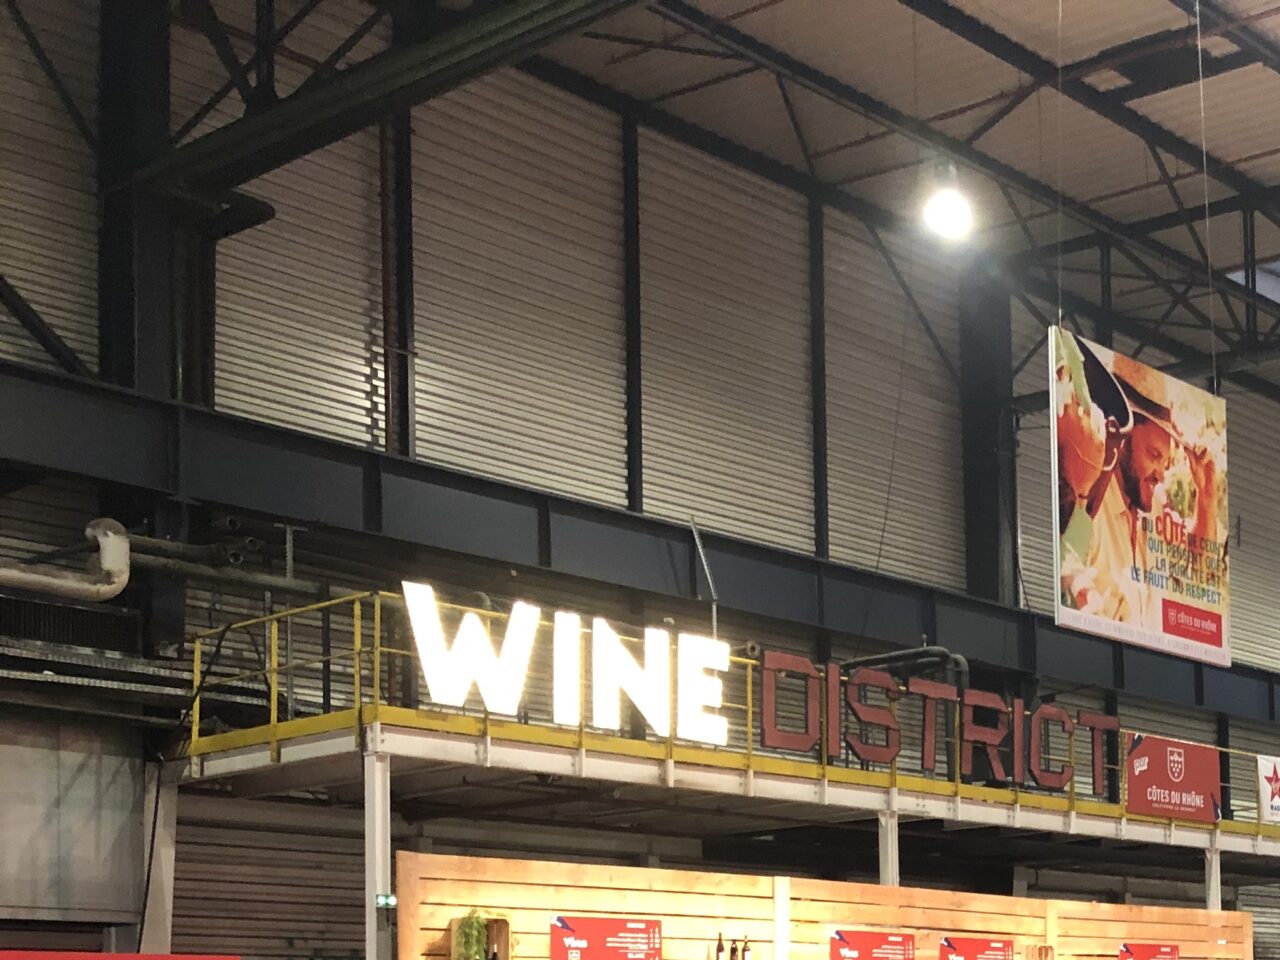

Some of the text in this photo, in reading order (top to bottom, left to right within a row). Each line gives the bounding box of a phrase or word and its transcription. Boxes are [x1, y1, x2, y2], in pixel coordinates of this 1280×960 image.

[1148, 537, 1163, 553] QUI
[1206, 555, 1221, 572] QUE
[1155, 556, 1166, 571] LA
[1186, 583, 1221, 605] RESPECT
[401, 580, 1120, 795] WINE DISTRICT
[1147, 785, 1204, 808] CÔTES DU RHÔNE
